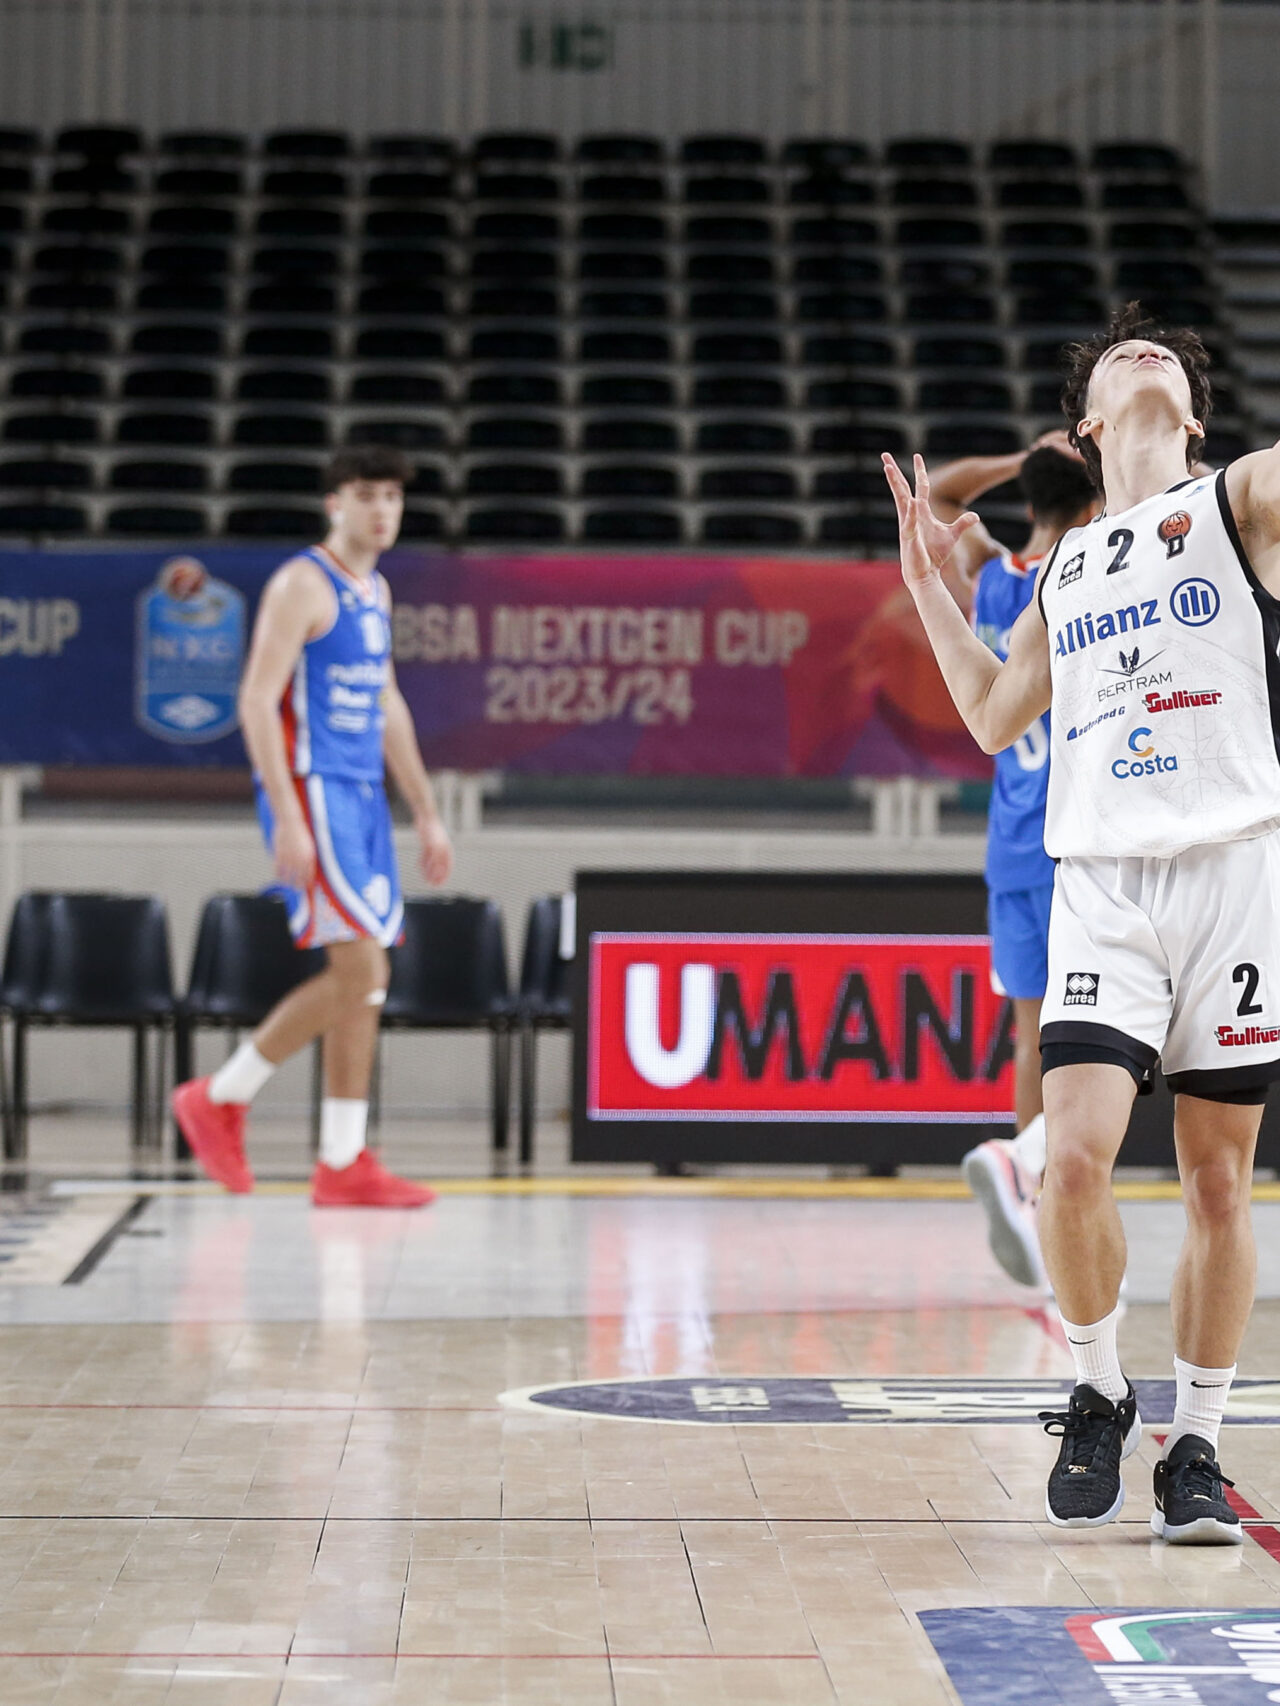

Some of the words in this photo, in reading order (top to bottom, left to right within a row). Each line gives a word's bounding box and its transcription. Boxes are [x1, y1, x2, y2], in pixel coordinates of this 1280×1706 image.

[1106, 528, 1135, 575] 2
[392, 602, 480, 663] BSA
[491, 605, 704, 665] NEXTGEN
[713, 608, 809, 667] CUP
[1055, 598, 1161, 662] Allianz
[485, 664, 696, 726] 2023/24
[1097, 671, 1173, 702] BERTRAM
[1145, 689, 1223, 714] Gulliver
[1111, 754, 1178, 780] Costa
[1064, 993, 1096, 1006] errea
[1232, 962, 1263, 1017] 2
